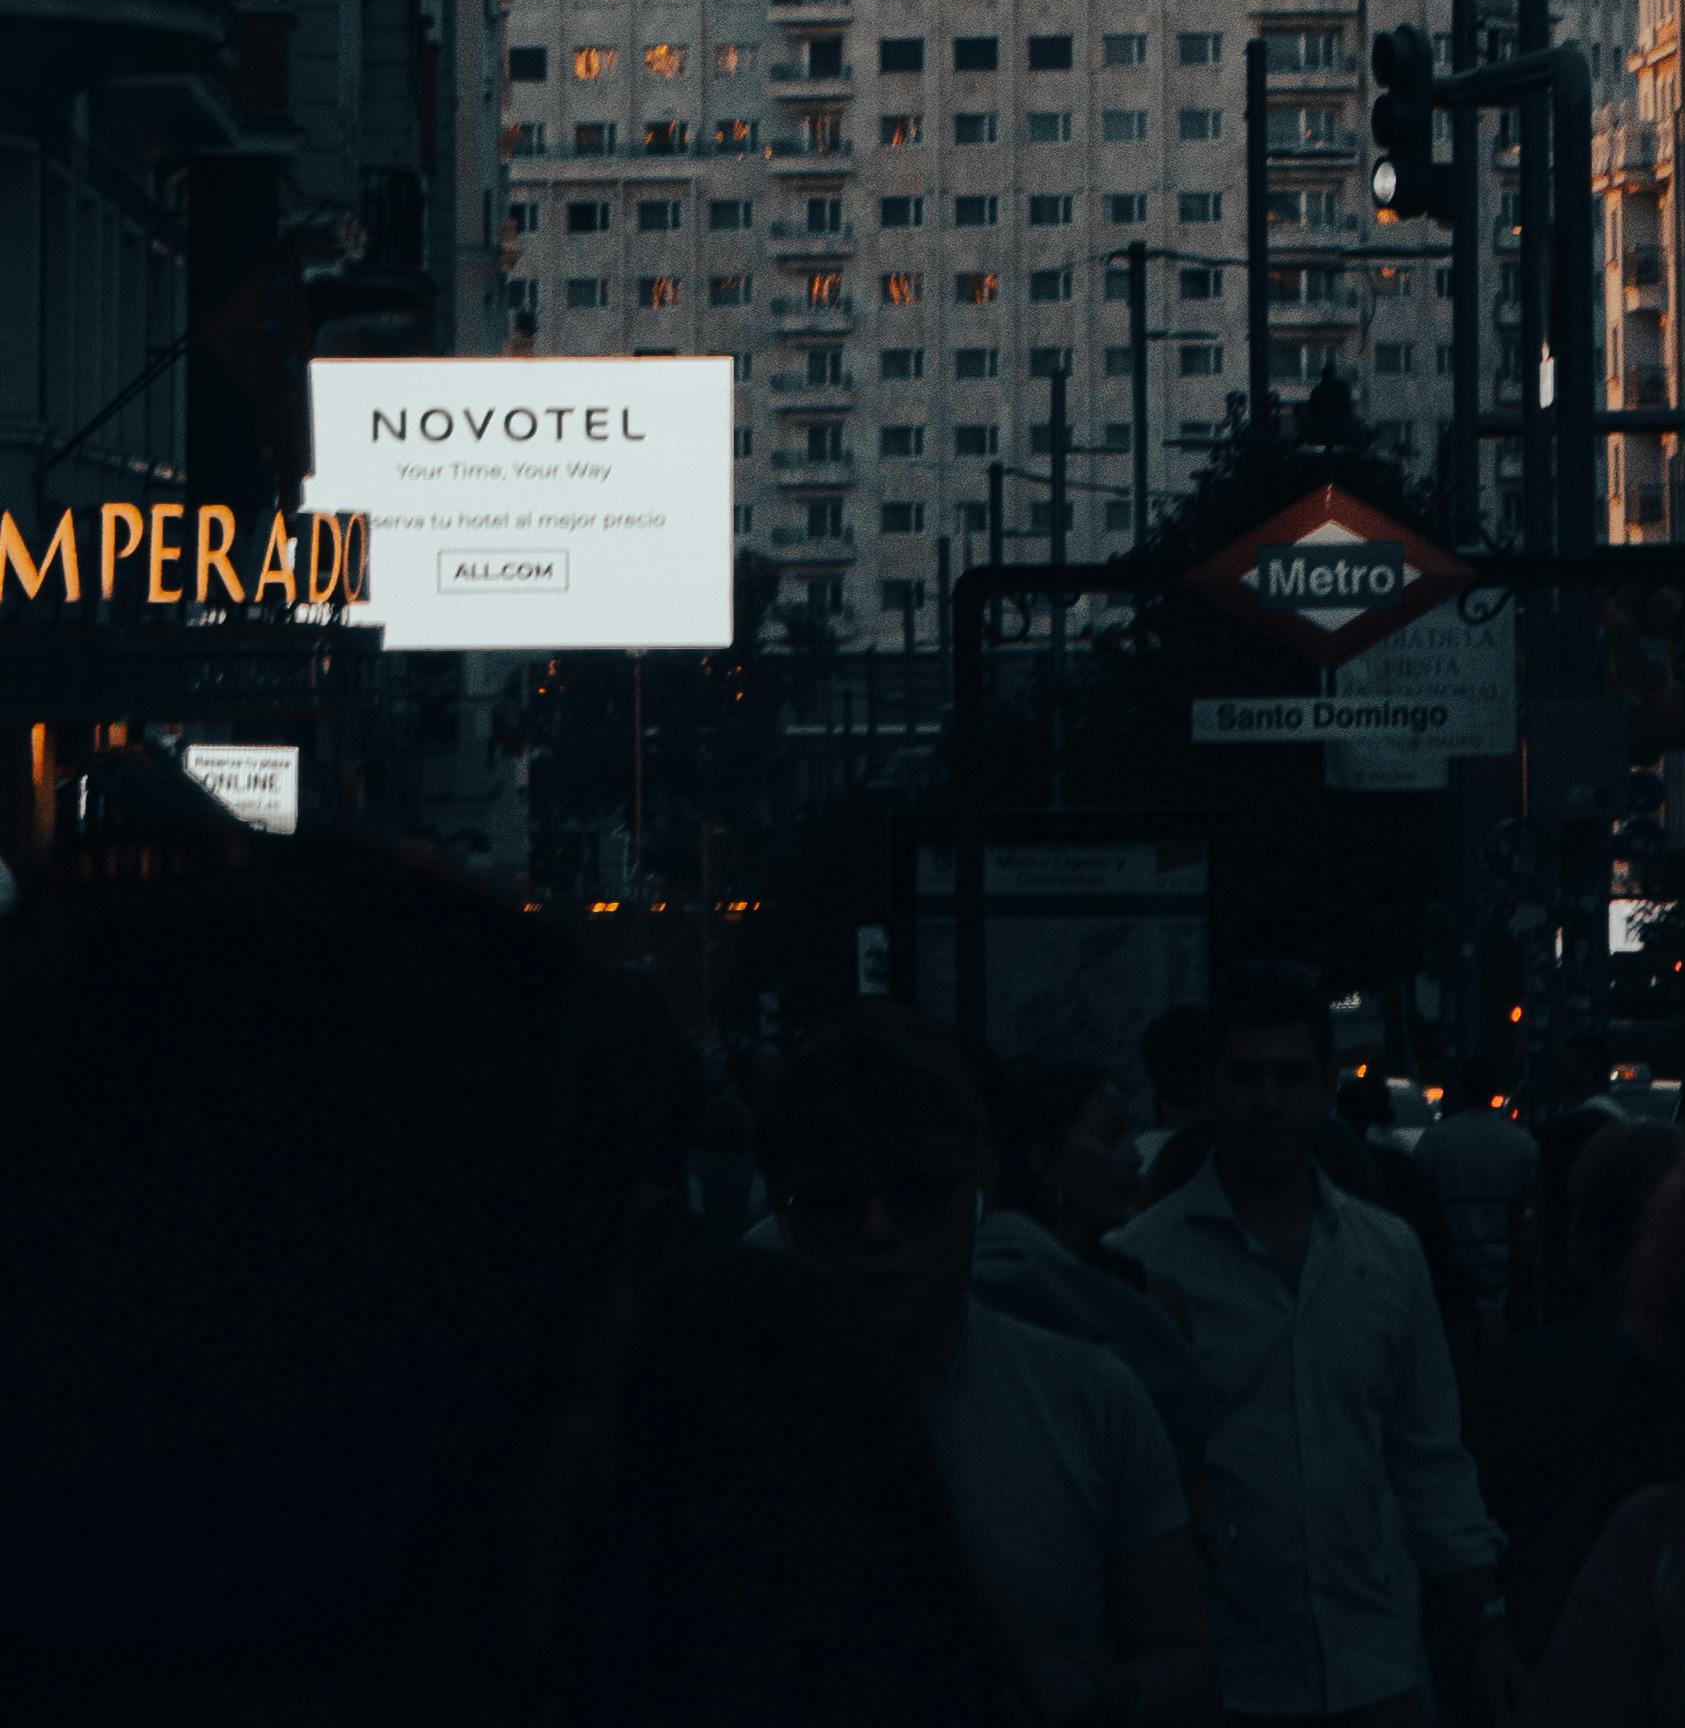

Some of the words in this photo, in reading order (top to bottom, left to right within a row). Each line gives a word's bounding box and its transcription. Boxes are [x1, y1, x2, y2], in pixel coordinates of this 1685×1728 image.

[371, 406, 646, 443] NOVOTEL
[397, 461, 444, 481] Your
[449, 461, 507, 483] Time,
[513, 461, 561, 481] Your
[566, 460, 613, 483] Way
[372, 515, 426, 531] serva
[430, 513, 453, 530] tu
[458, 512, 510, 531] hotel
[514, 512, 533, 530] al
[538, 512, 597, 533] mejor
[602, 511, 667, 533] precio
[0, 501, 367, 605] MPERADO
[453, 561, 554, 582] ALL.COM
[1267, 557, 1397, 597] Metro
[1217, 704, 1302, 731] Santo
[1313, 700, 1449, 734] Domingo
